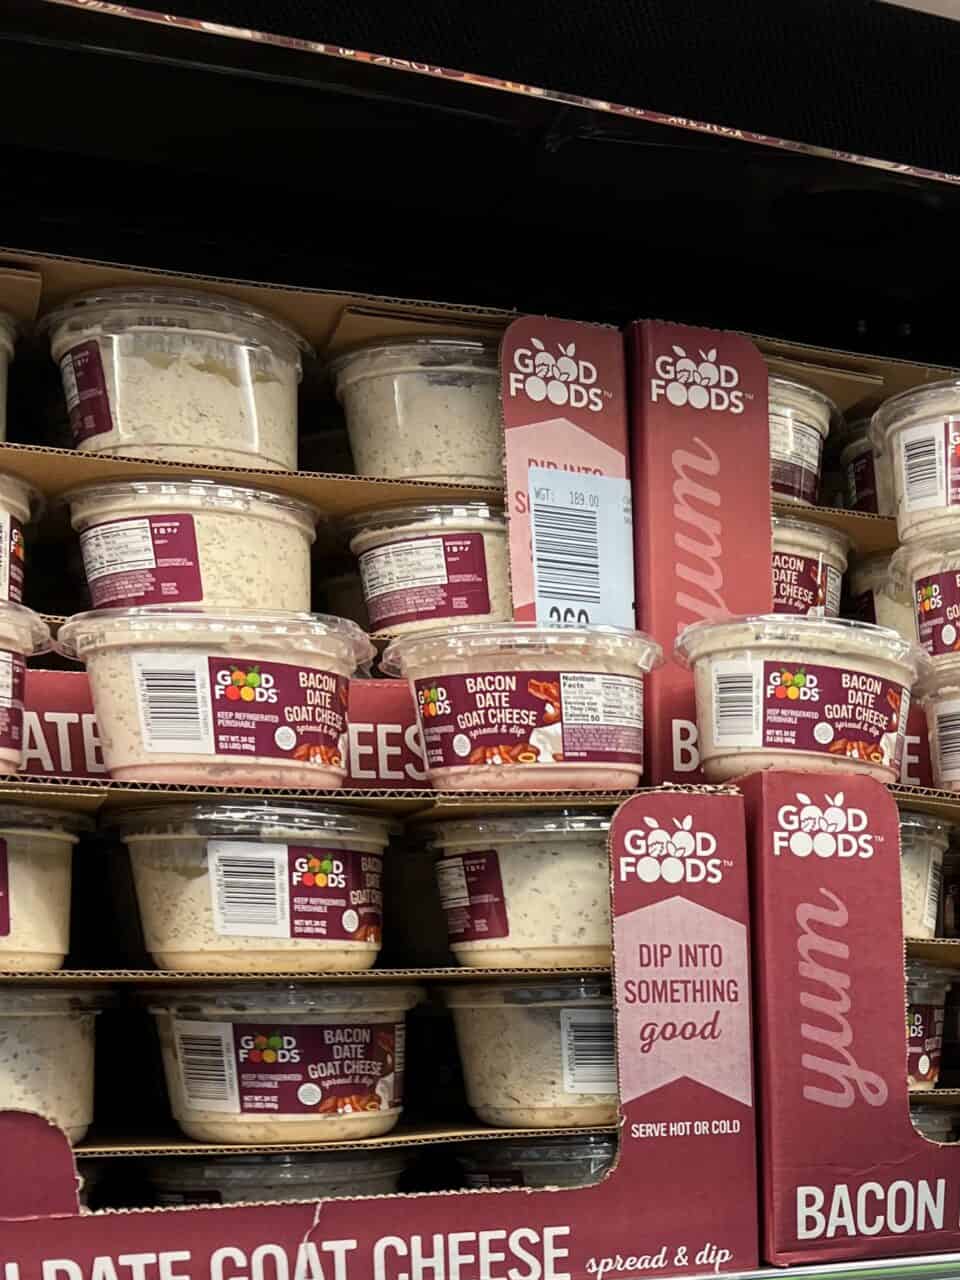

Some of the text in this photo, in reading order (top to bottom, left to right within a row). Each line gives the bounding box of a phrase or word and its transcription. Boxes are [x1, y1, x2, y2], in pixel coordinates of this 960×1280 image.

[513, 343, 598, 384] GOOD
[509, 373, 604, 411] FOODS
[217, 666, 274, 688] GOOD
[299, 671, 336, 694] BACON
[466, 675, 516, 694] BACON
[842, 673, 882, 692] BACON
[215, 686, 278, 703] FOODS
[306, 690, 332, 709] DATE
[476, 692, 509, 709] DATE
[848, 690, 875, 708] DATE
[284, 706, 343, 729] GOAT CHEESE
[457, 709, 537, 728] GOAT CHEESE
[778, 803, 868, 832] GOOD
[624, 826, 717, 857] GOOD
[773, 831, 874, 858] FOODS
[619, 855, 723, 883] FOODS
[640, 944, 723, 967] DIP INTO
[624, 979, 739, 1003] SOMETHING
[796, 888, 888, 1108] yum
[241, 1033, 296, 1049] GOOD
[324, 1029, 371, 1045] BACON
[640, 1011, 721, 1054] good
[239, 1049, 300, 1063] FOODS
[333, 1045, 364, 1060] DATE
[308, 1061, 383, 1079] GOAT CHEESE
[632, 1120, 740, 1138] SERVE HOT OR COLD
[797, 1177, 947, 1240] BACON
[674, 1246, 690, 1267] &
[695, 1244, 733, 1272] dip
